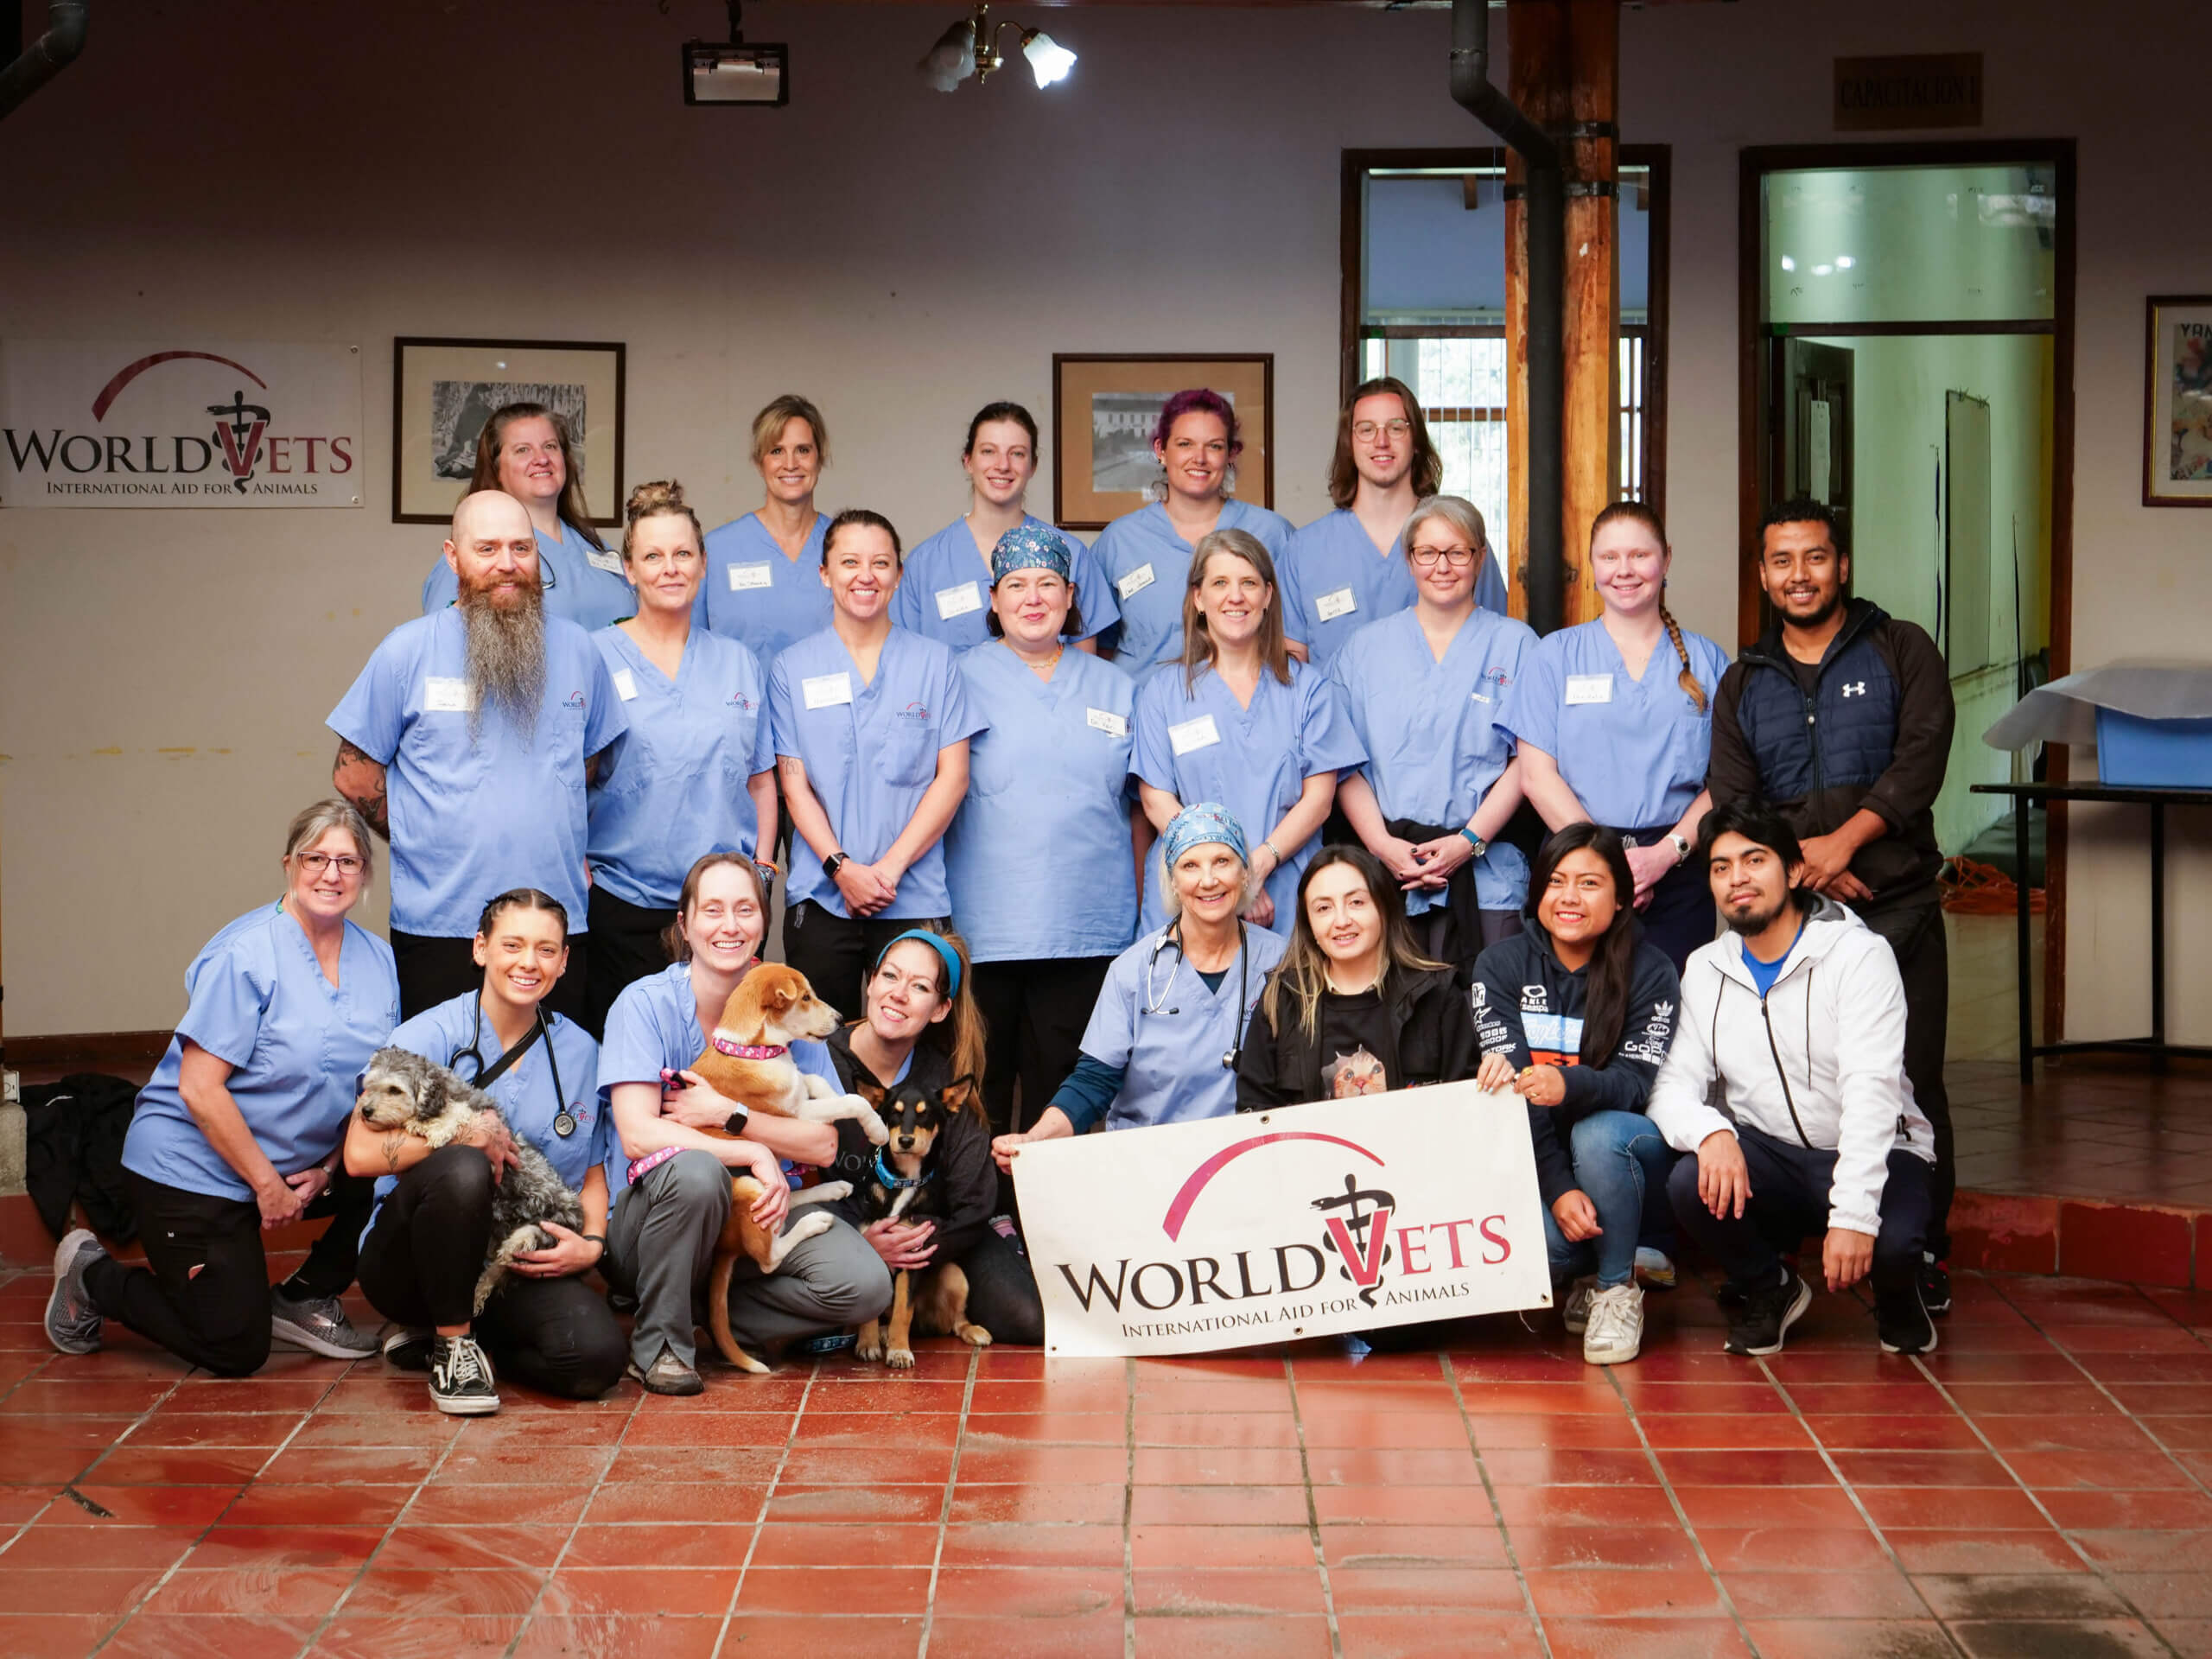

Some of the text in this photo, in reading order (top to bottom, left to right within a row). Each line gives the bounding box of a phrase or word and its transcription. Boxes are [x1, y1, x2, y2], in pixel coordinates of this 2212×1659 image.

[47, 481, 318, 495] INTERNATIONAL AID FOR ANIMALS
[1122, 1282, 1471, 1338] INTERNATIONAL AID FOR ANIMALS
